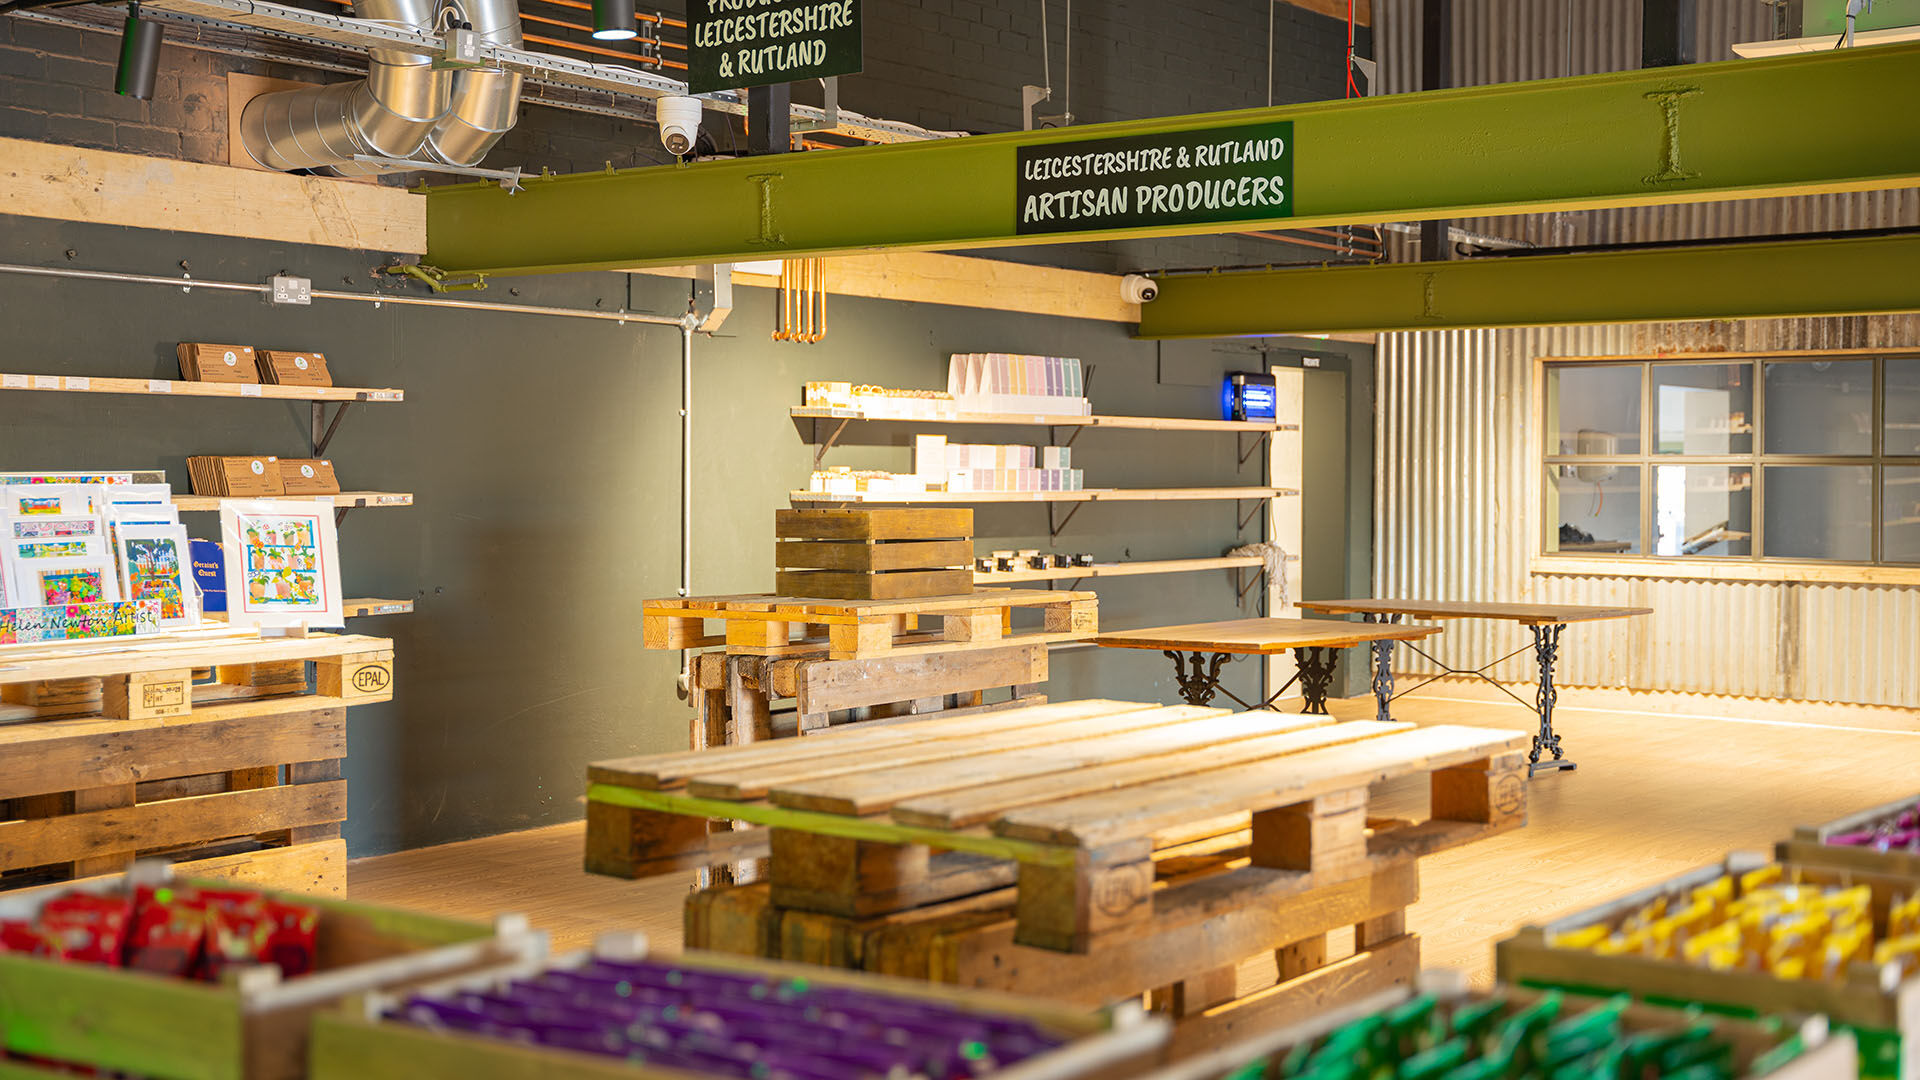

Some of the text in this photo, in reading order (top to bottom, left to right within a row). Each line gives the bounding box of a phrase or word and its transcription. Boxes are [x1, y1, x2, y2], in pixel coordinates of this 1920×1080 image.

[695, 0, 854, 48] LEICESTERSHIRE
[719, 38, 827, 78] & RUTLAND
[1024, 137, 1284, 181] LEICESTERSHIRE & RUTLAND
[1023, 175, 1285, 224] ARTISAN PRODUCERS
[0, 609, 153, 633] Helen Newton Artist
[358, 671, 385, 687] EPAL
